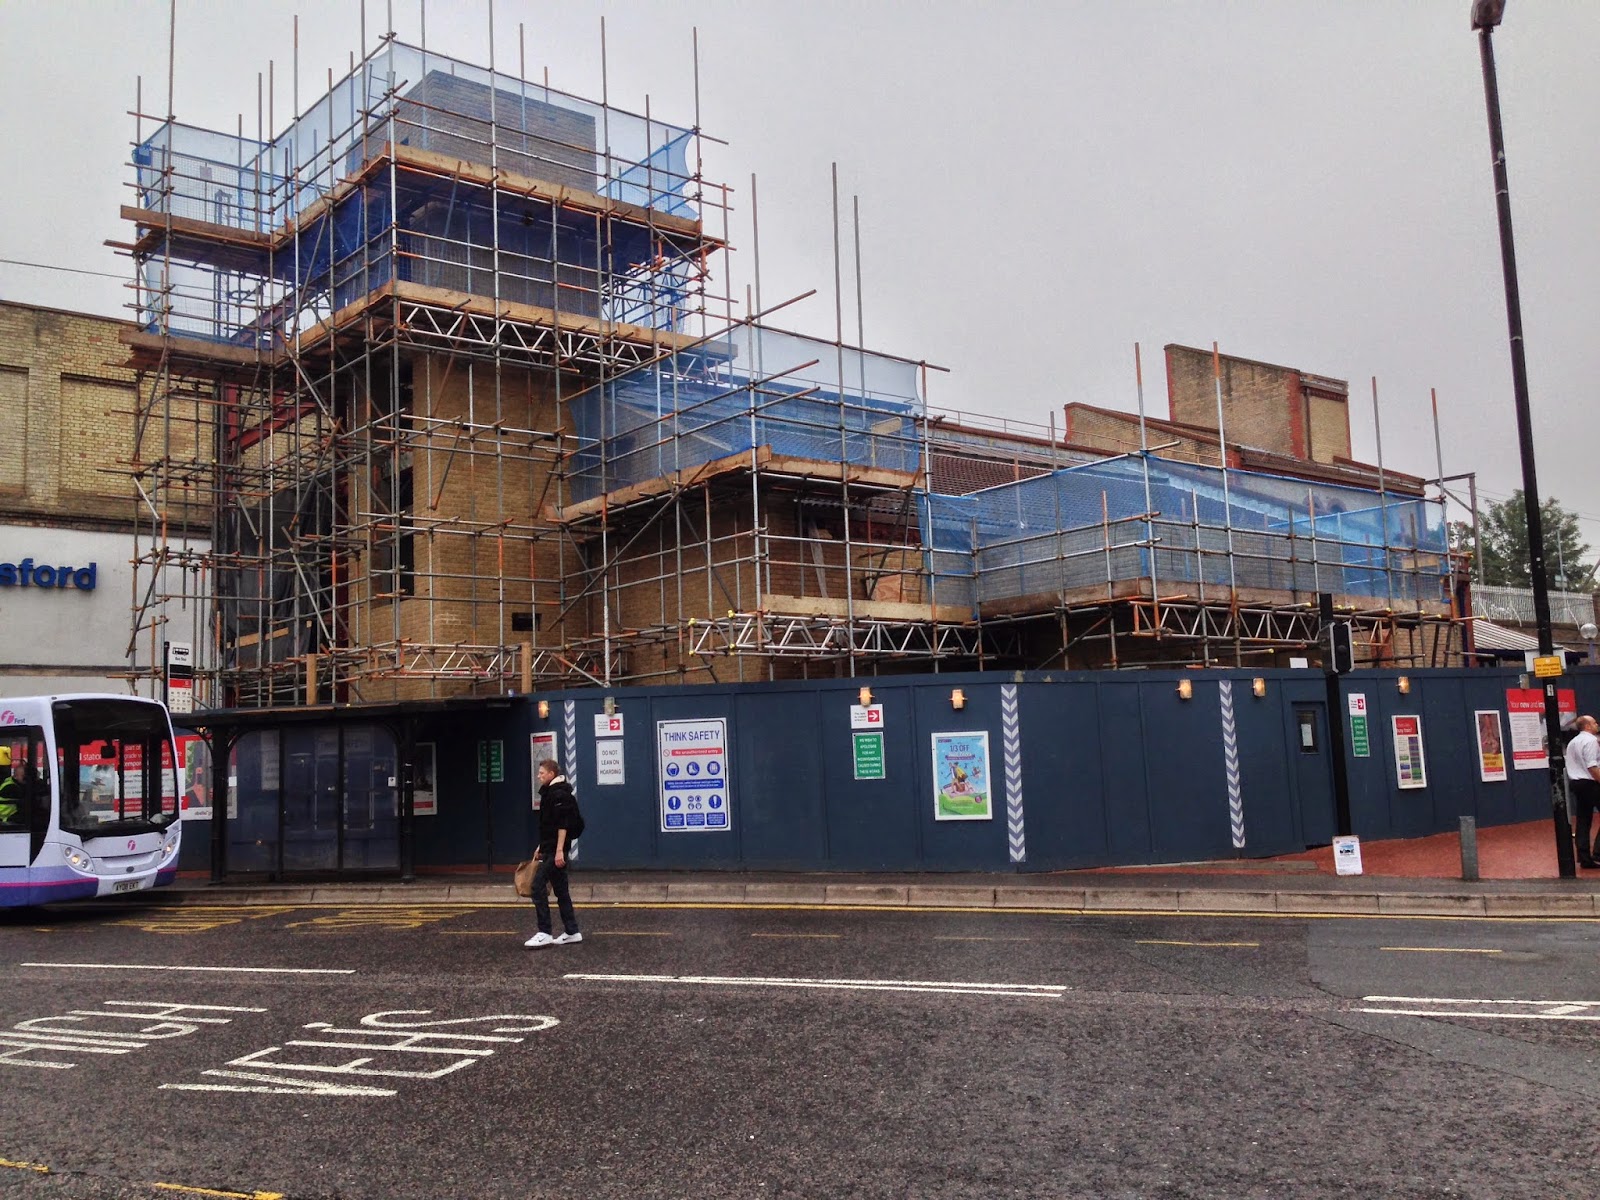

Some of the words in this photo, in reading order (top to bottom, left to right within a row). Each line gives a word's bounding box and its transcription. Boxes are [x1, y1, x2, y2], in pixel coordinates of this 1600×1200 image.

[664, 731, 687, 741] THINK
[688, 730, 720, 741] SAFETY
[949, 744, 958, 752] 1/3
[958, 744, 970, 752] OFF
